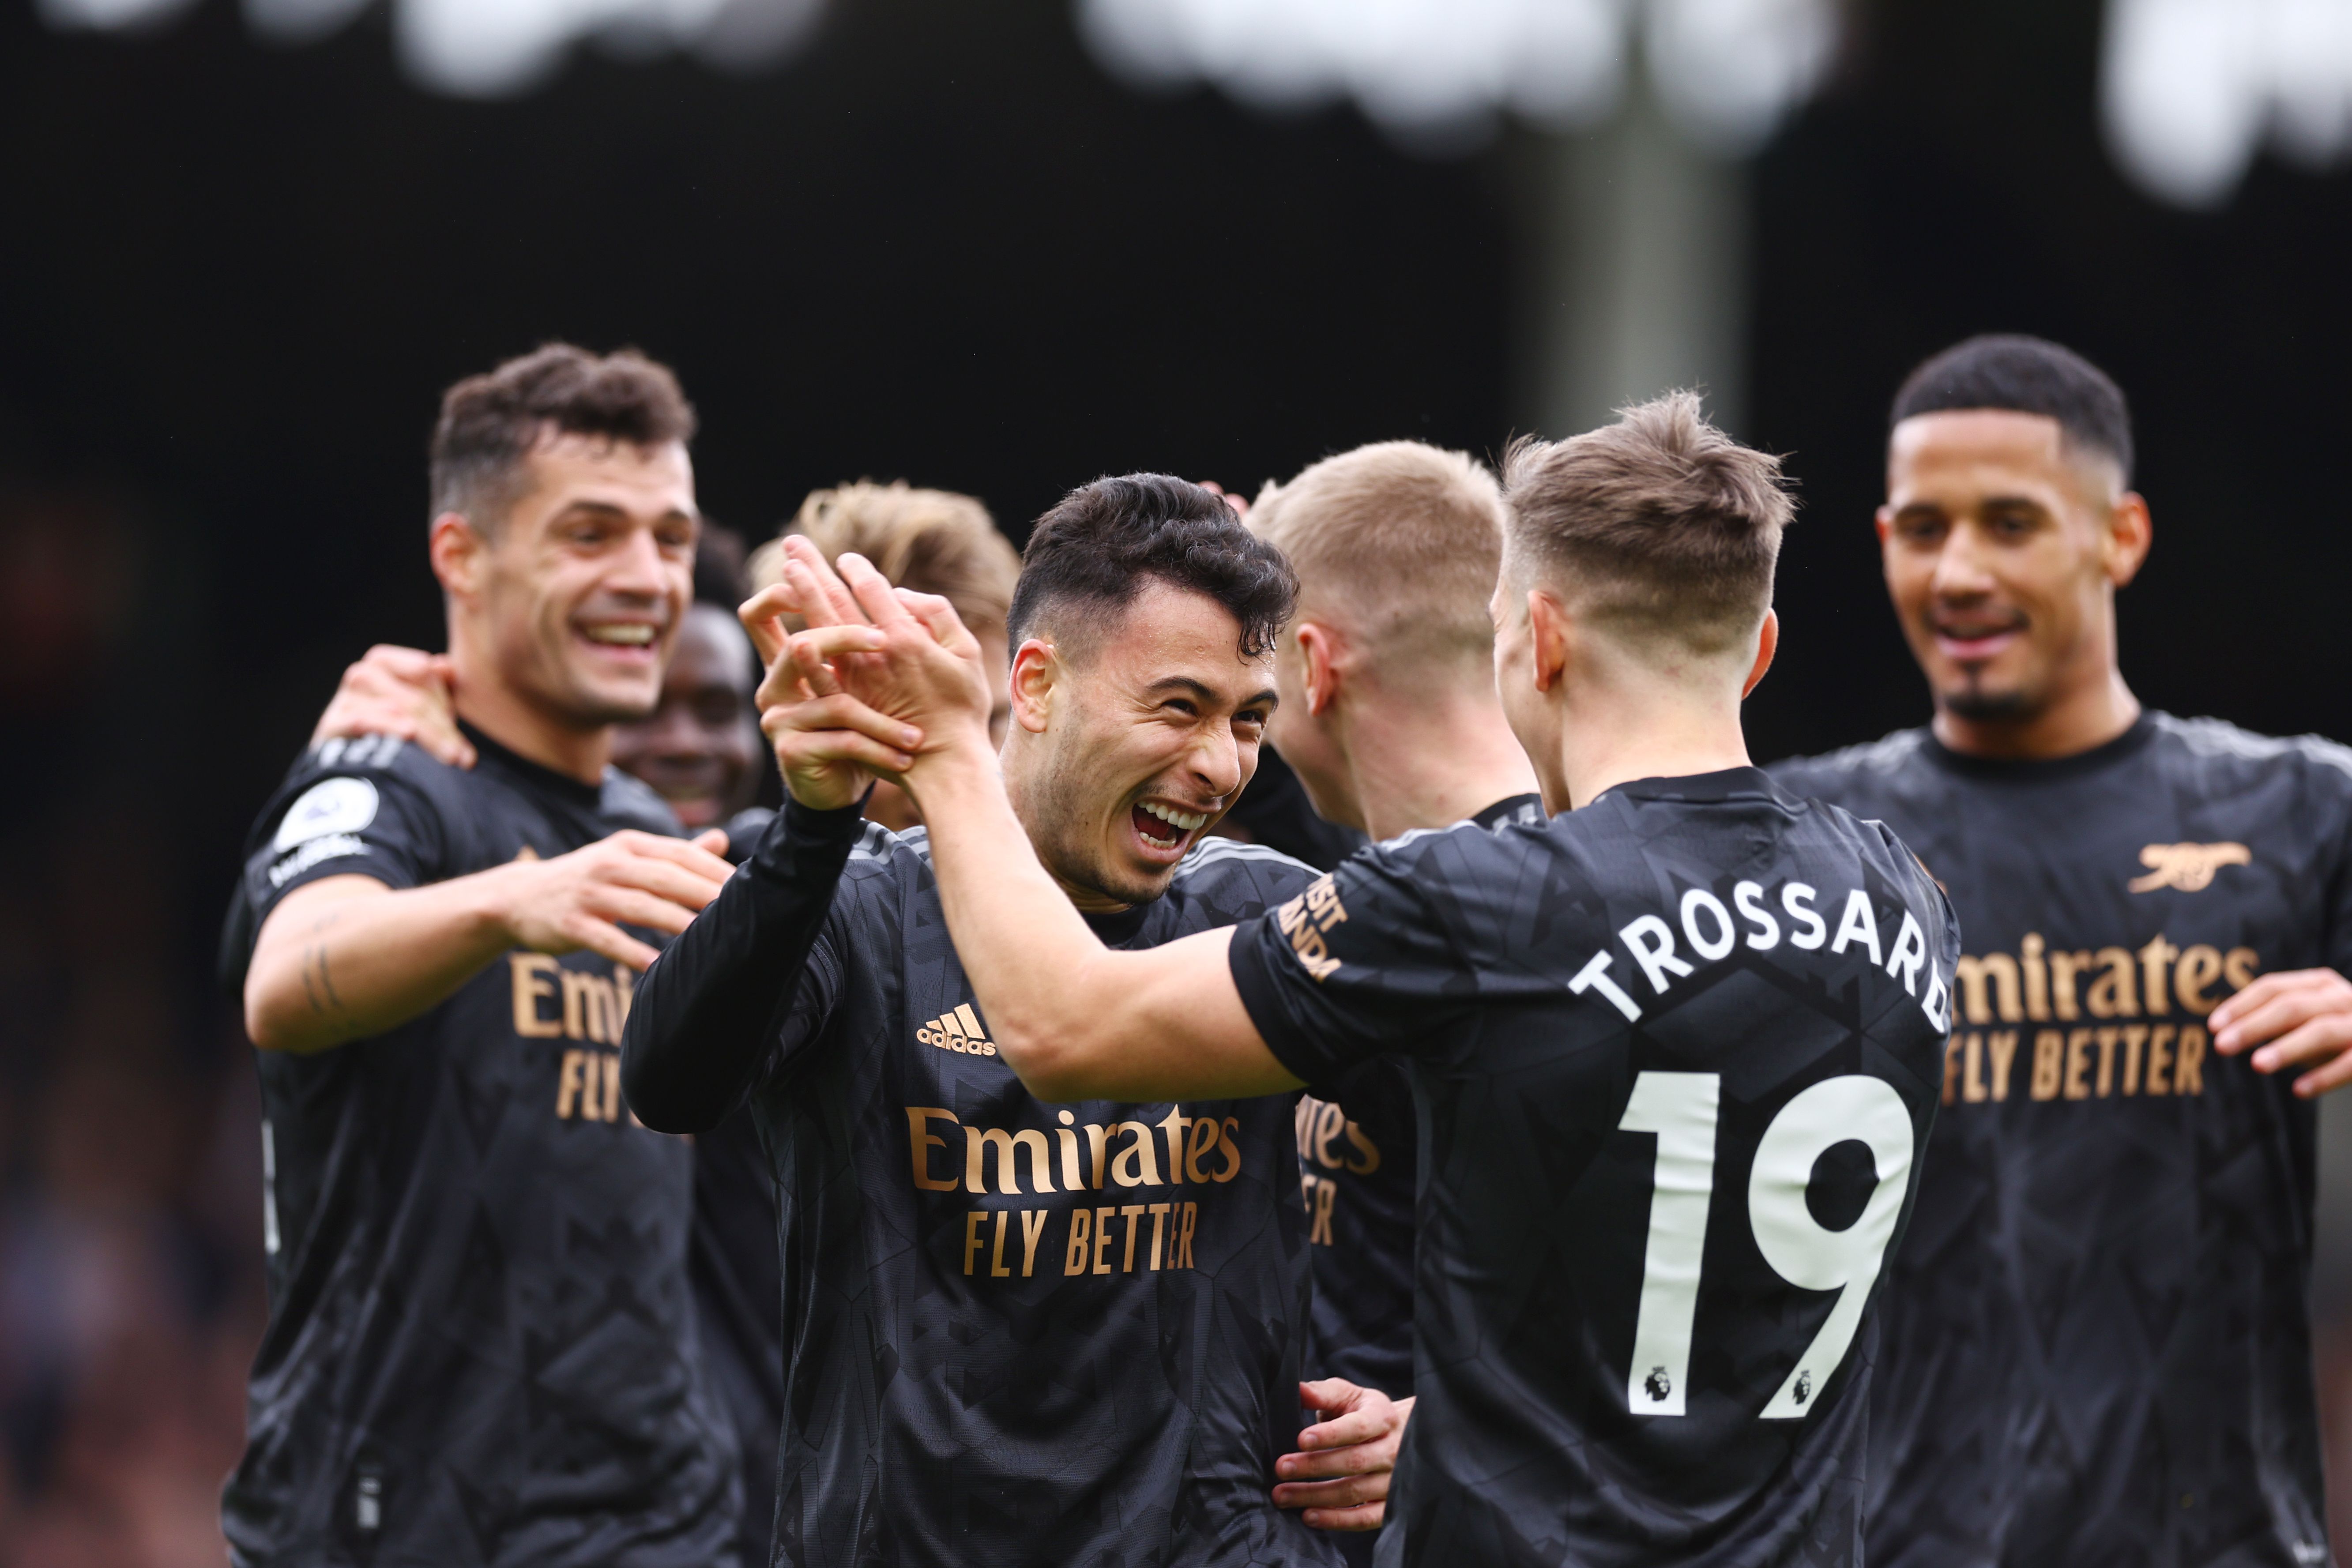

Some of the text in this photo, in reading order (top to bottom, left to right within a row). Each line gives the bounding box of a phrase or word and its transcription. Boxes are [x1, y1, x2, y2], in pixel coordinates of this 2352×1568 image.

[1567, 880, 1947, 1033] TROSSARD
[1952, 931, 2260, 1027] mirates
[916, 1028, 996, 1056] adidas
[2029, 1023, 2206, 1102] BETTER
[905, 1103, 1241, 1194] Emirates
[963, 1201, 1197, 1278] FLY BETTER
[1617, 1070, 1915, 1419] 19
